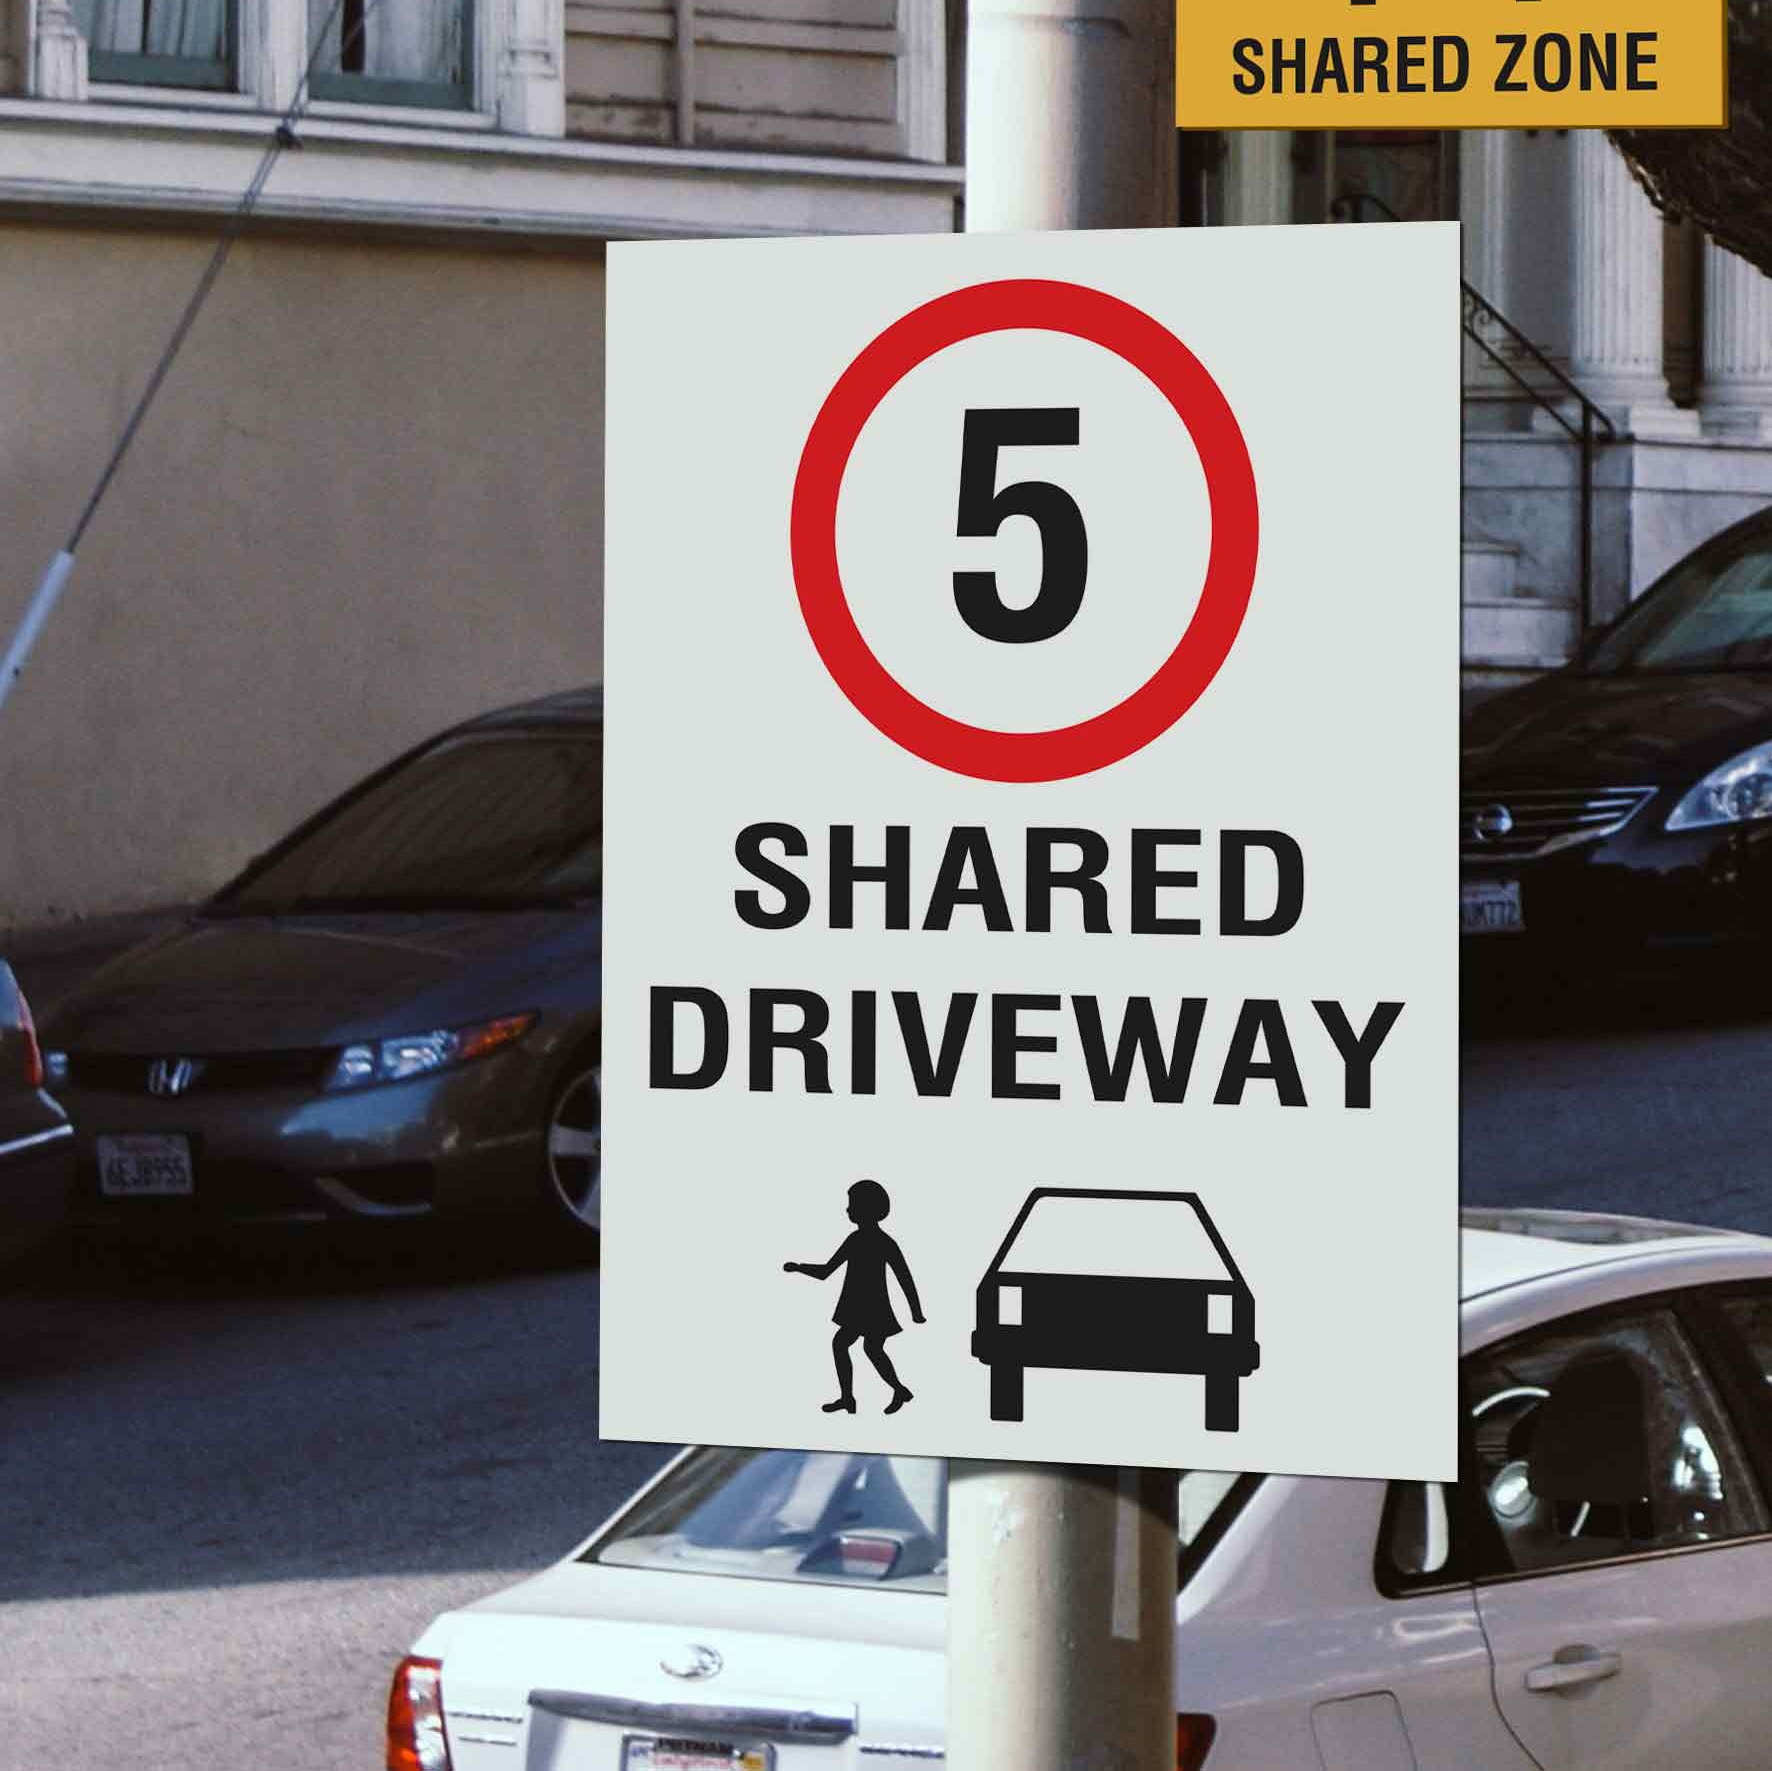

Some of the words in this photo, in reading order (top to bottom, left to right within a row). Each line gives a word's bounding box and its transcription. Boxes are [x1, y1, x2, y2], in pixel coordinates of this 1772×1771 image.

[1231, 34, 1470, 96] SHARED
[1493, 30, 1659, 93] ZONE
[951, 407, 1089, 645] 5
[733, 821, 1305, 938] SHARED
[648, 985, 1406, 1110] DRIVEWAY
